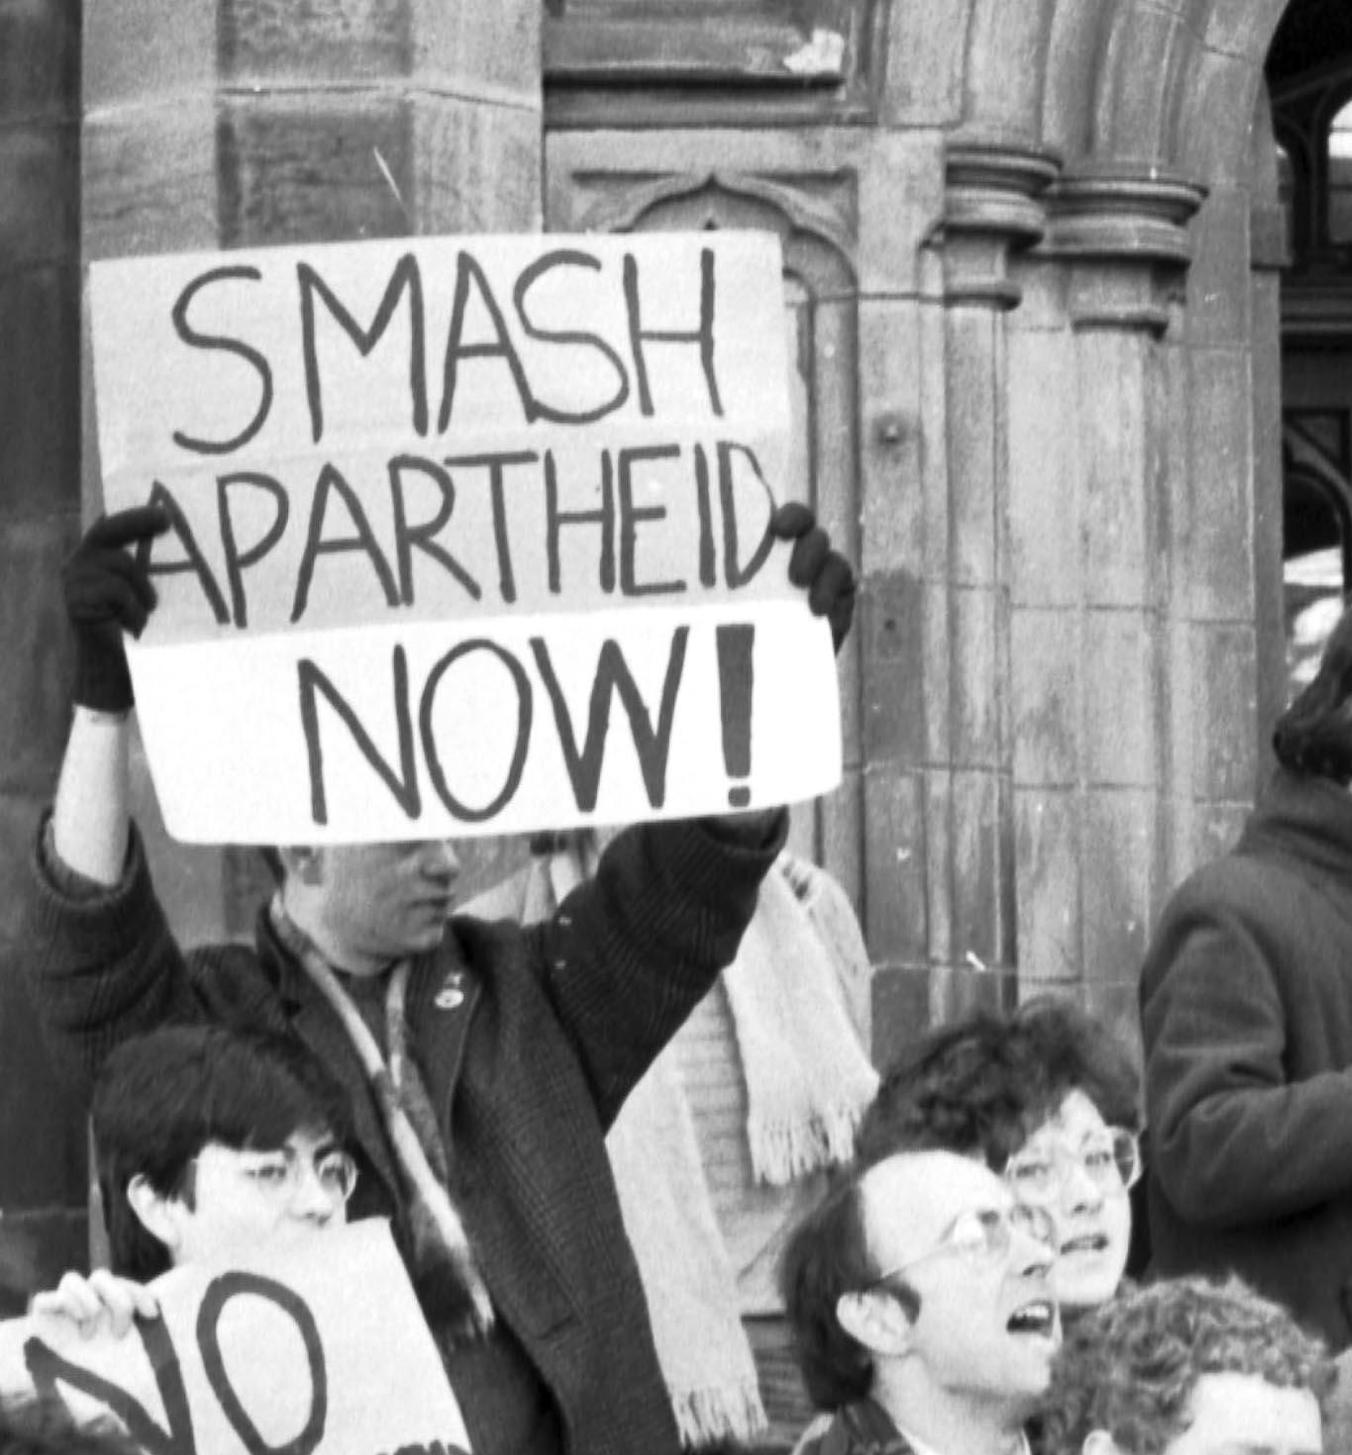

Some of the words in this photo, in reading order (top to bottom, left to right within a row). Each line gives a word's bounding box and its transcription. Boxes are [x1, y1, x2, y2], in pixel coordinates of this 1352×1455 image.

[171, 248, 724, 454] SMASH
[136, 441, 780, 628] APARTHEID
[297, 623, 756, 825] NOW!
